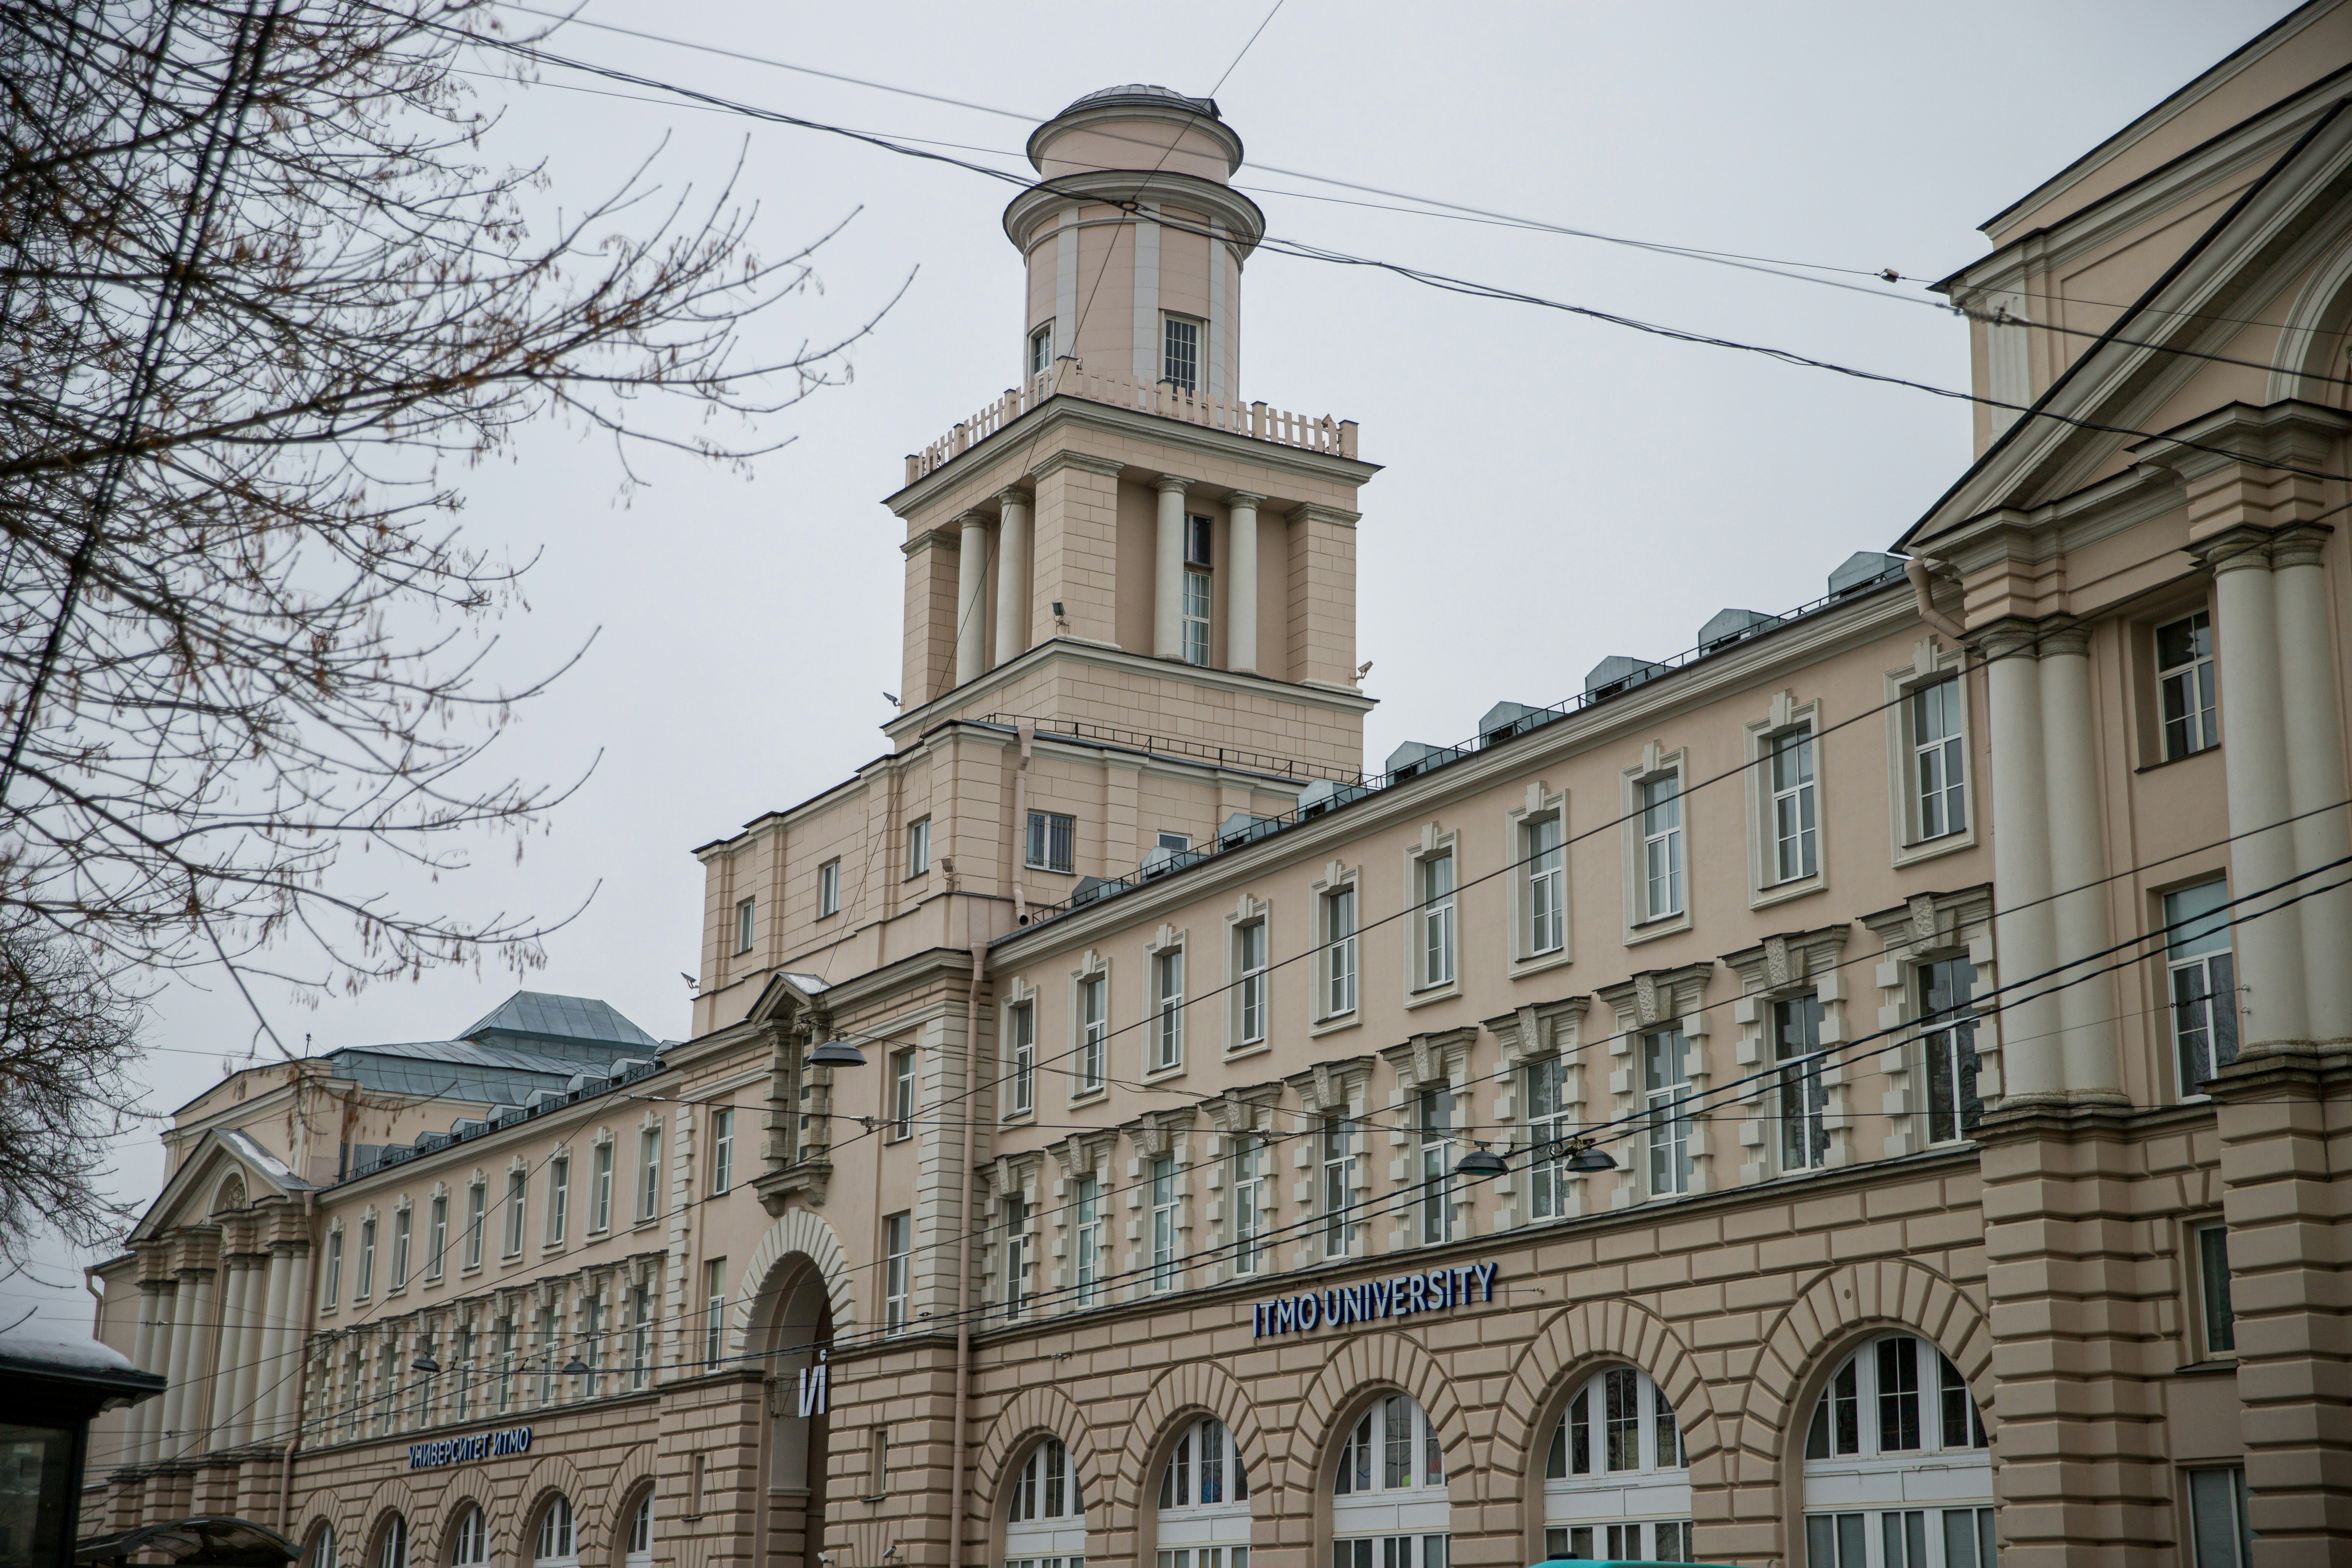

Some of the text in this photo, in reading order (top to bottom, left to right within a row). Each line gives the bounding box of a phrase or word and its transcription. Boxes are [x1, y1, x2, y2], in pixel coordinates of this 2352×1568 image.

[1253, 1262, 1497, 1338] ITMO UNIVERSITY
[409, 1427, 531, 1468] УНИВЕРСИТЕТ ИТМО
